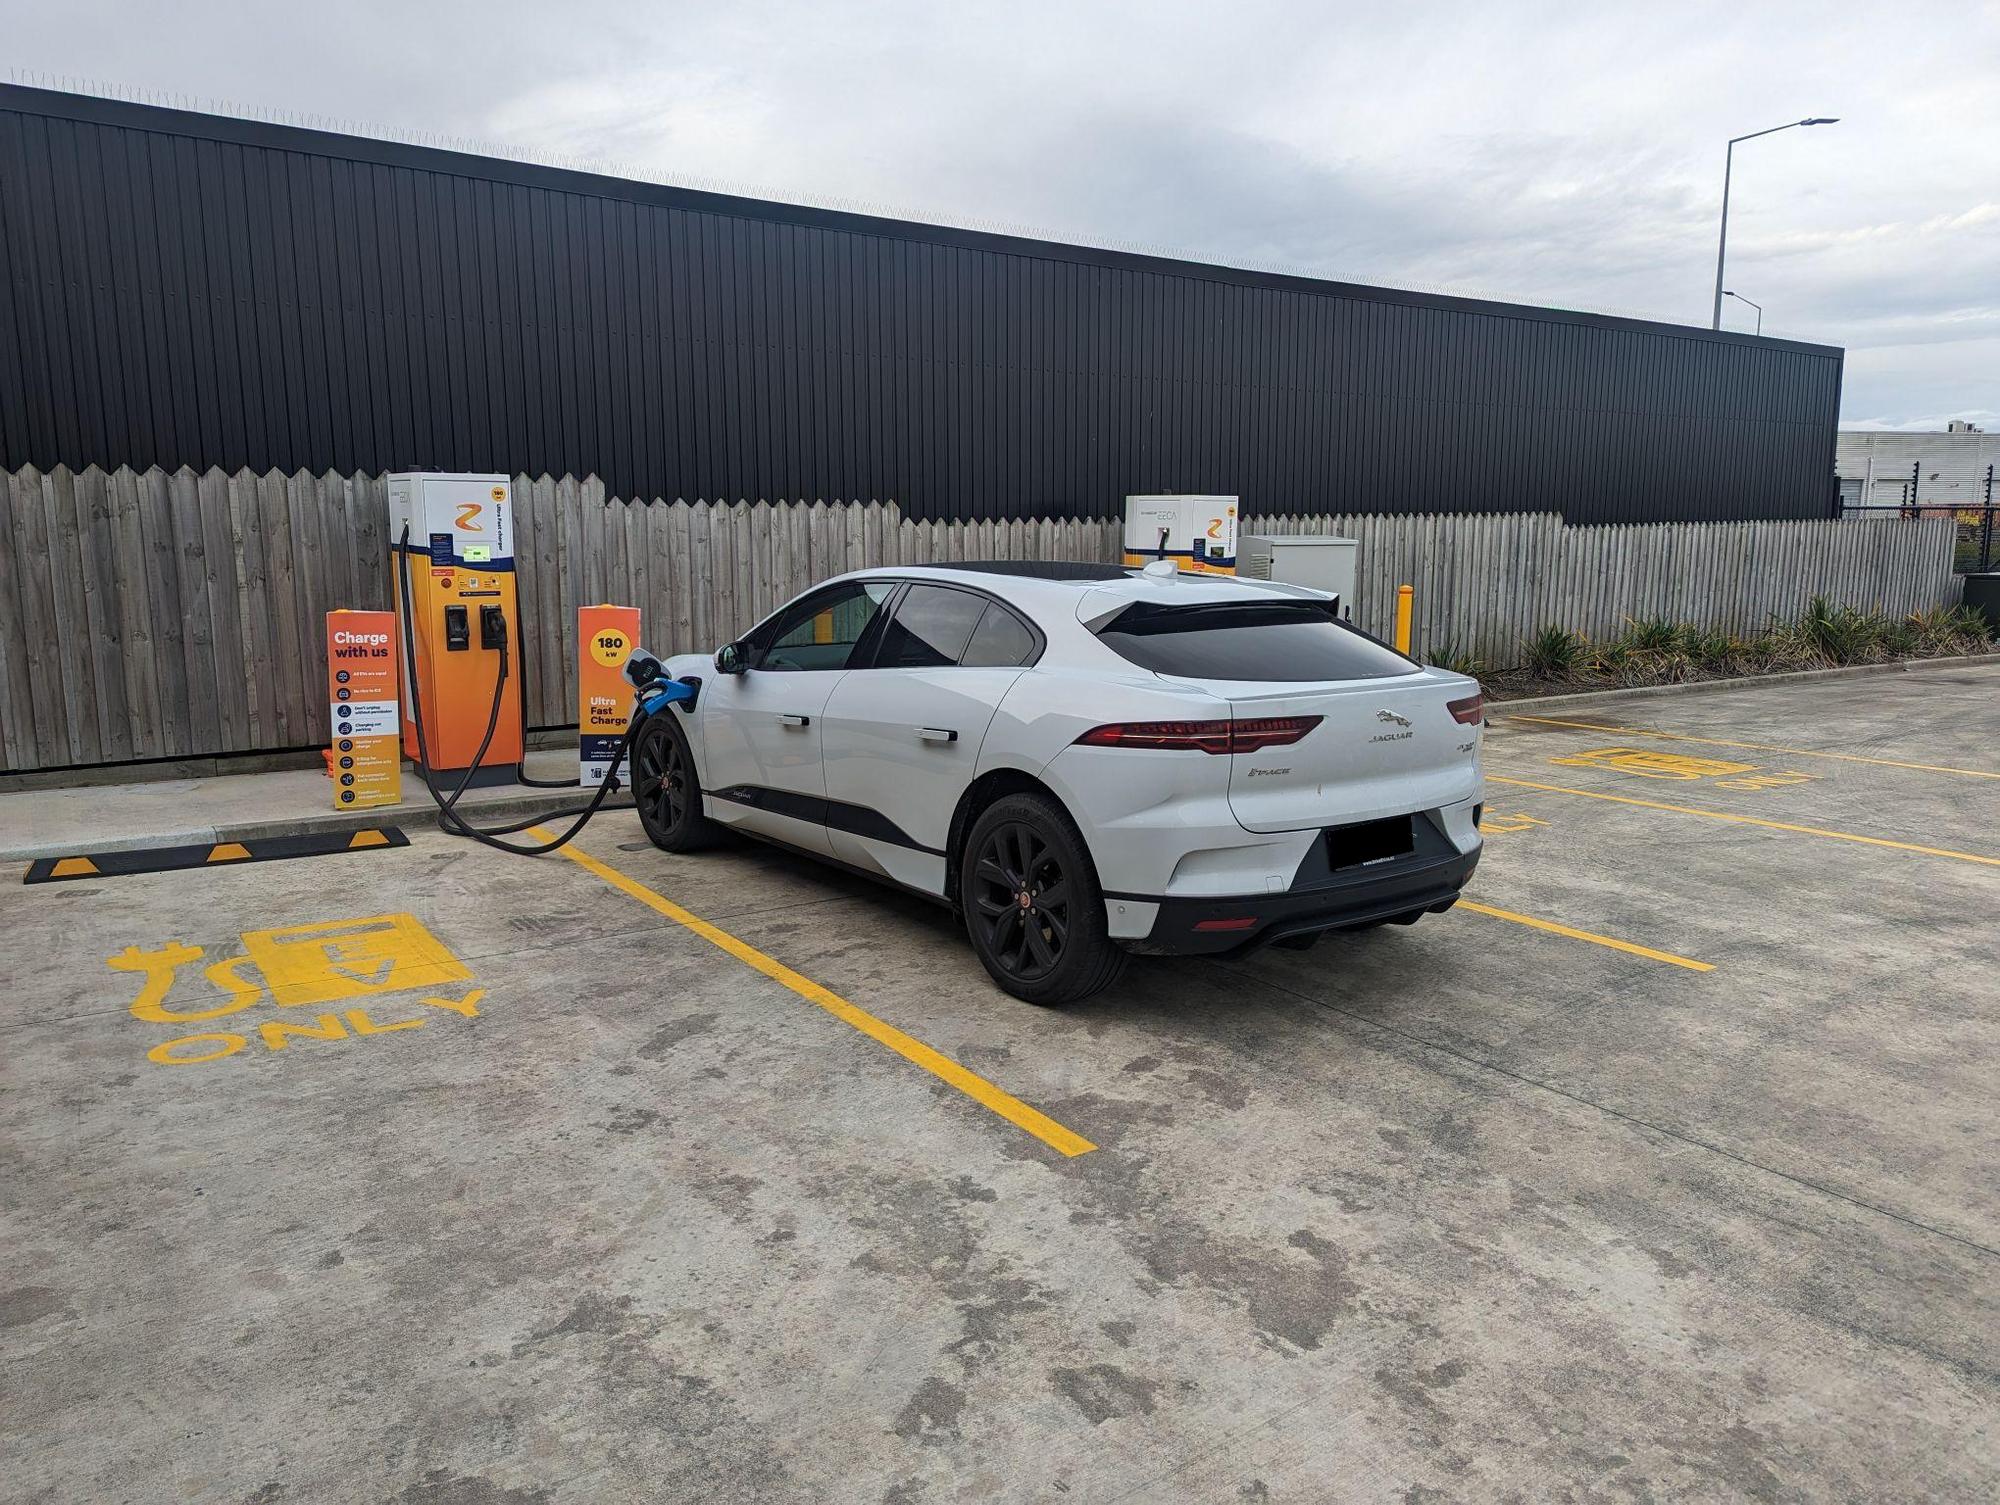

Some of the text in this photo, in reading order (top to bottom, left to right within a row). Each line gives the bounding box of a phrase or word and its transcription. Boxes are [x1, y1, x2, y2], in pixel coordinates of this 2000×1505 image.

[334, 631, 388, 646] Charge
[597, 637, 622, 649] 180
[335, 646, 388, 658] with us
[590, 697, 617, 706] Ultra
[590, 707, 613, 715] Fast
[590, 716, 628, 726] Charge
[1368, 731, 1414, 743] JAGUAR
[320, 940, 397, 986] EV
[147, 989, 487, 1065] ONLY
